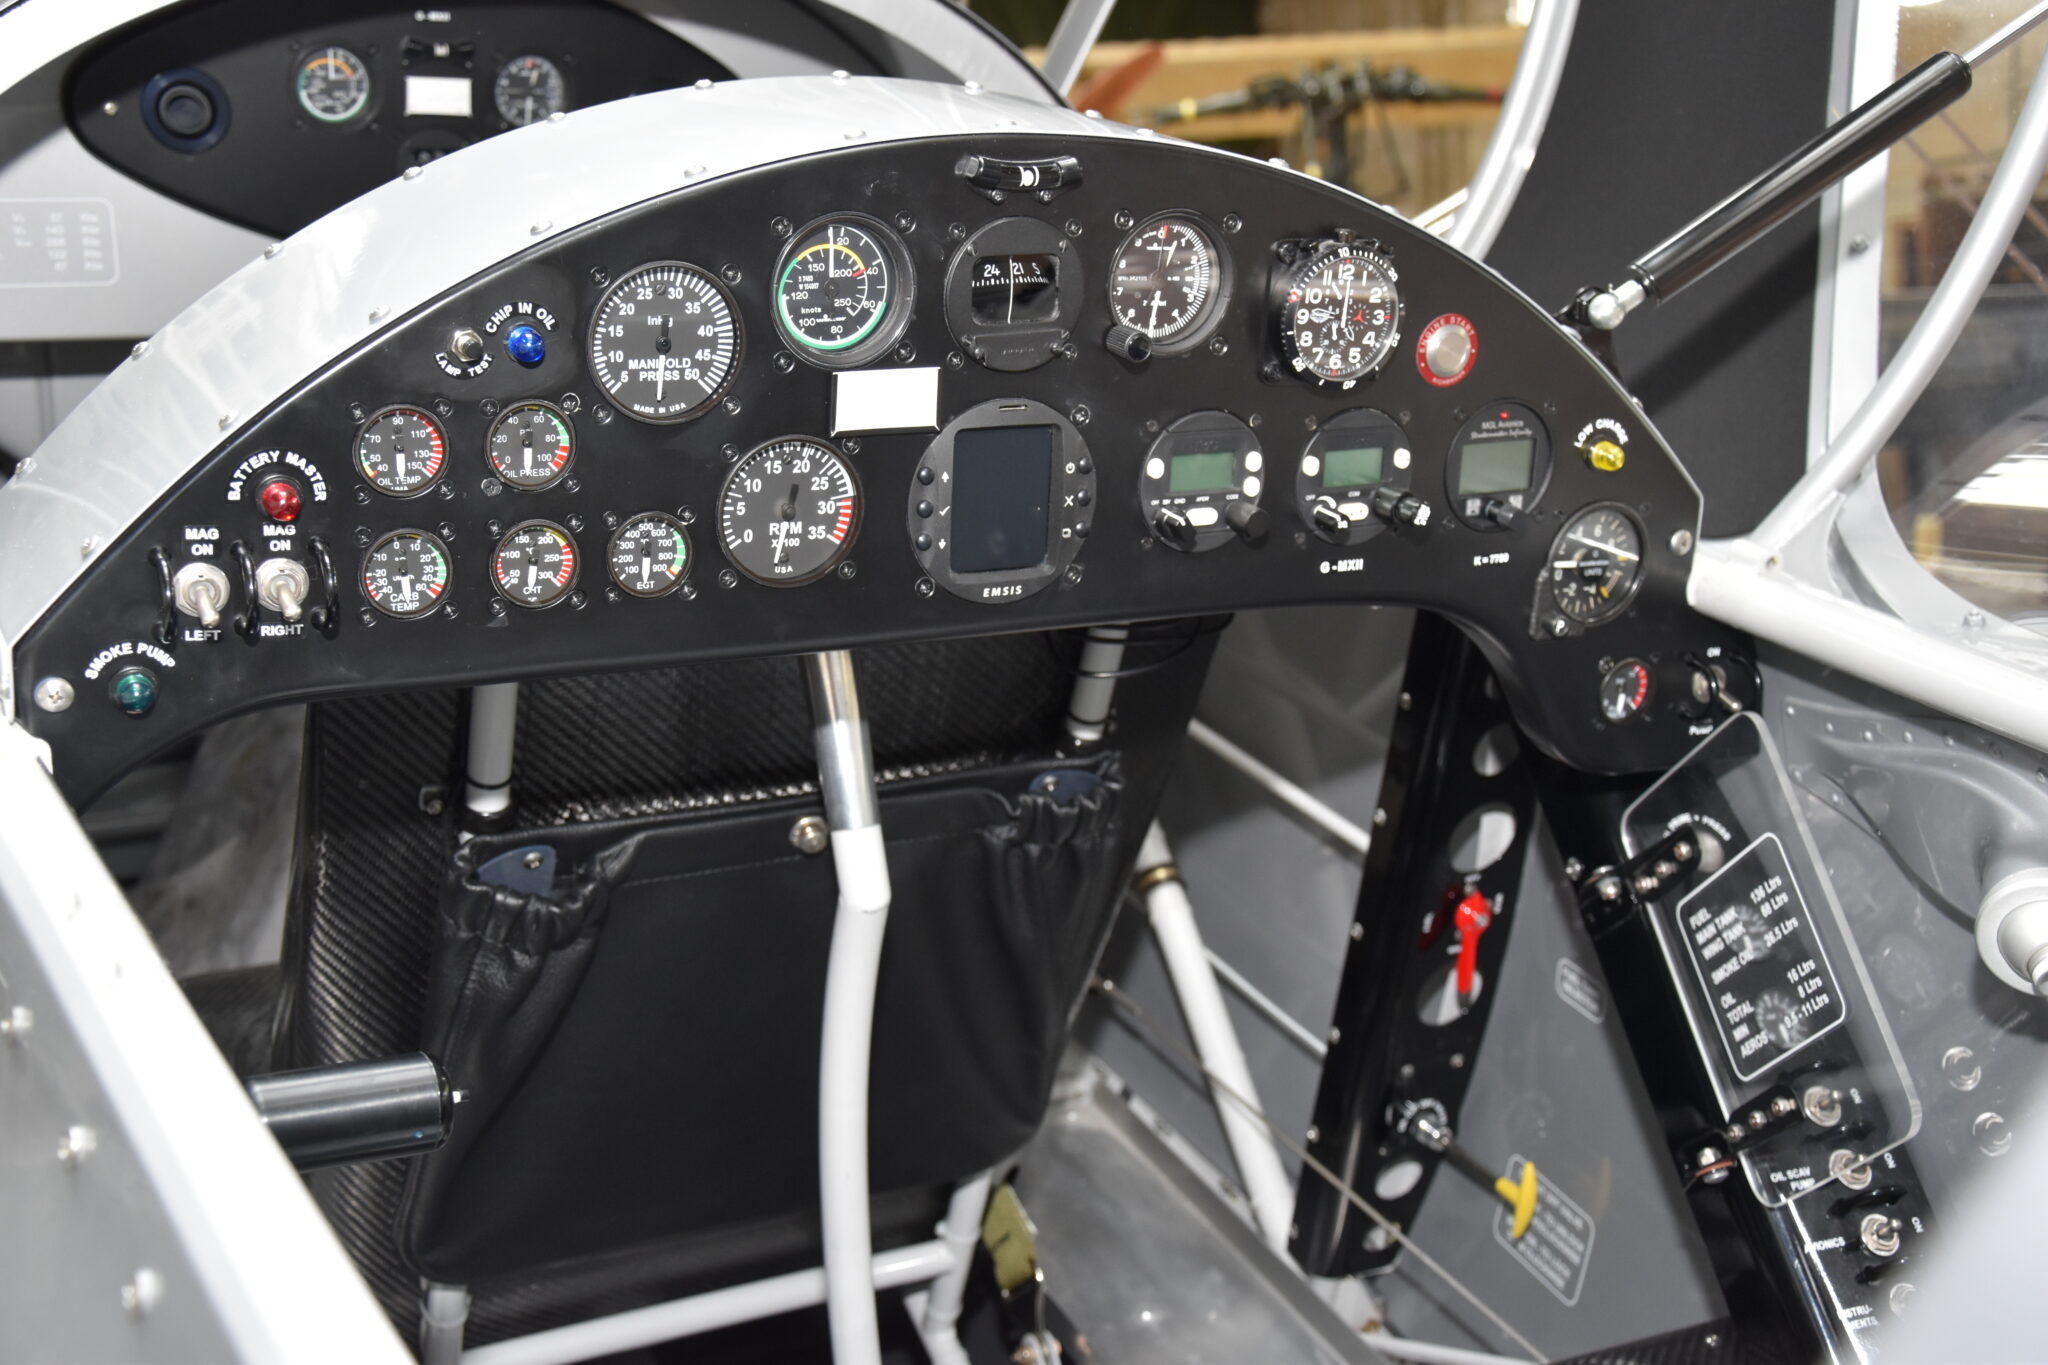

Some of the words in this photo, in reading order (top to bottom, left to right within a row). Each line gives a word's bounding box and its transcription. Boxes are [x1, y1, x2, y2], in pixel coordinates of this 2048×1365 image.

[1338, 247, 1349, 257] 10
[808, 264, 825, 272] 150
[834, 269, 852, 277] 200
[984, 264, 1000, 277] 24
[1012, 263, 1024, 275] 21
[1339, 264, 1355, 280] 12
[1388, 268, 1398, 281] 20
[1323, 270, 1332, 285] 11
[1363, 271, 1367, 286] 1
[637, 289, 652, 299] 25
[668, 288, 683, 299] 30
[1305, 288, 1322, 303] 10
[1369, 287, 1382, 303] 2
[685, 303, 700, 314] 35
[834, 298, 851, 306] 250
[619, 303, 634, 315] 20
[486, 305, 512, 332] CHIP
[518, 302, 532, 314] IN
[536, 308, 555, 330] OIL
[799, 318, 815, 326] 100
[1297, 309, 1309, 324] 9
[1372, 310, 1385, 325] 3
[608, 326, 623, 336] 15
[698, 326, 713, 336] 40
[831, 326, 843, 334] 80
[1450, 316, 1474, 335] START
[1300, 331, 1312, 347] 8
[1362, 331, 1375, 347] 4
[608, 351, 623, 362] 10
[695, 349, 710, 360] 45
[1312, 348, 1324, 363] 7
[1349, 348, 1360, 363] 5
[436, 353, 461, 376] LAMP
[468, 354, 492, 376] TEST
[629, 358, 691, 369] MANIOLD
[1330, 354, 1341, 369] 6
[621, 371, 628, 382] 5
[684, 369, 699, 380] 50
[634, 404, 654, 413] MADE
[670, 403, 686, 412] USA
[393, 417, 403, 425] 90
[411, 430, 425, 438] 110
[1574, 423, 1593, 448] LOW
[765, 461, 782, 474] 15
[792, 460, 810, 473] 20
[228, 450, 279, 500] BATTERY
[285, 452, 326, 501] MASTER
[395, 476, 421, 484] TEMP
[744, 479, 761, 492] 10
[811, 477, 829, 490] 25
[736, 502, 745, 515] 5
[818, 501, 835, 514] 30
[263, 525, 296, 536] MAG
[639, 523, 653, 531] 500
[808, 526, 825, 539] 35
[185, 528, 219, 540] MAG
[744, 529, 753, 542] 0
[270, 540, 291, 551] ON
[785, 538, 799, 546] 100
[191, 544, 213, 555] ON
[544, 554, 559, 562] 250
[523, 586, 542, 594] CHT
[637, 581, 655, 589] EGT
[983, 586, 1022, 597] EMSIS
[391, 602, 419, 611] TEMP
[185, 630, 221, 641] LEFT
[261, 624, 304, 636] RIGHT
[1707, 647, 1721, 657] ON
[85, 642, 133, 679] SMOKE
[137, 642, 175, 667] PUMP
[1695, 922, 1717, 946] MAIN
[1715, 906, 1738, 930] TANK
[1764, 876, 1782, 894] Ltrs
[1689, 907, 1711, 930] FUEL
[1722, 921, 1746, 945] TANK
[1771, 892, 1789, 911] Ltrs
[1711, 956, 1740, 985] SMOKE
[1781, 917, 1799, 935] Ltrs
[1804, 976, 1822, 994] Ltrs
[1727, 1000, 1754, 1025] TOTAL
[1788, 968, 1799, 984] 16
[1797, 959, 1815, 977] Ltrs
[1741, 1030, 1768, 1059] AEROS
[1811, 993, 1829, 1011] Ltrs
[1850, 1087, 1862, 1105] ON
[1884, 1153, 1896, 1168] ON
[1787, 1167, 1811, 1179] SCAV
[1912, 1216, 1923, 1233] ON
